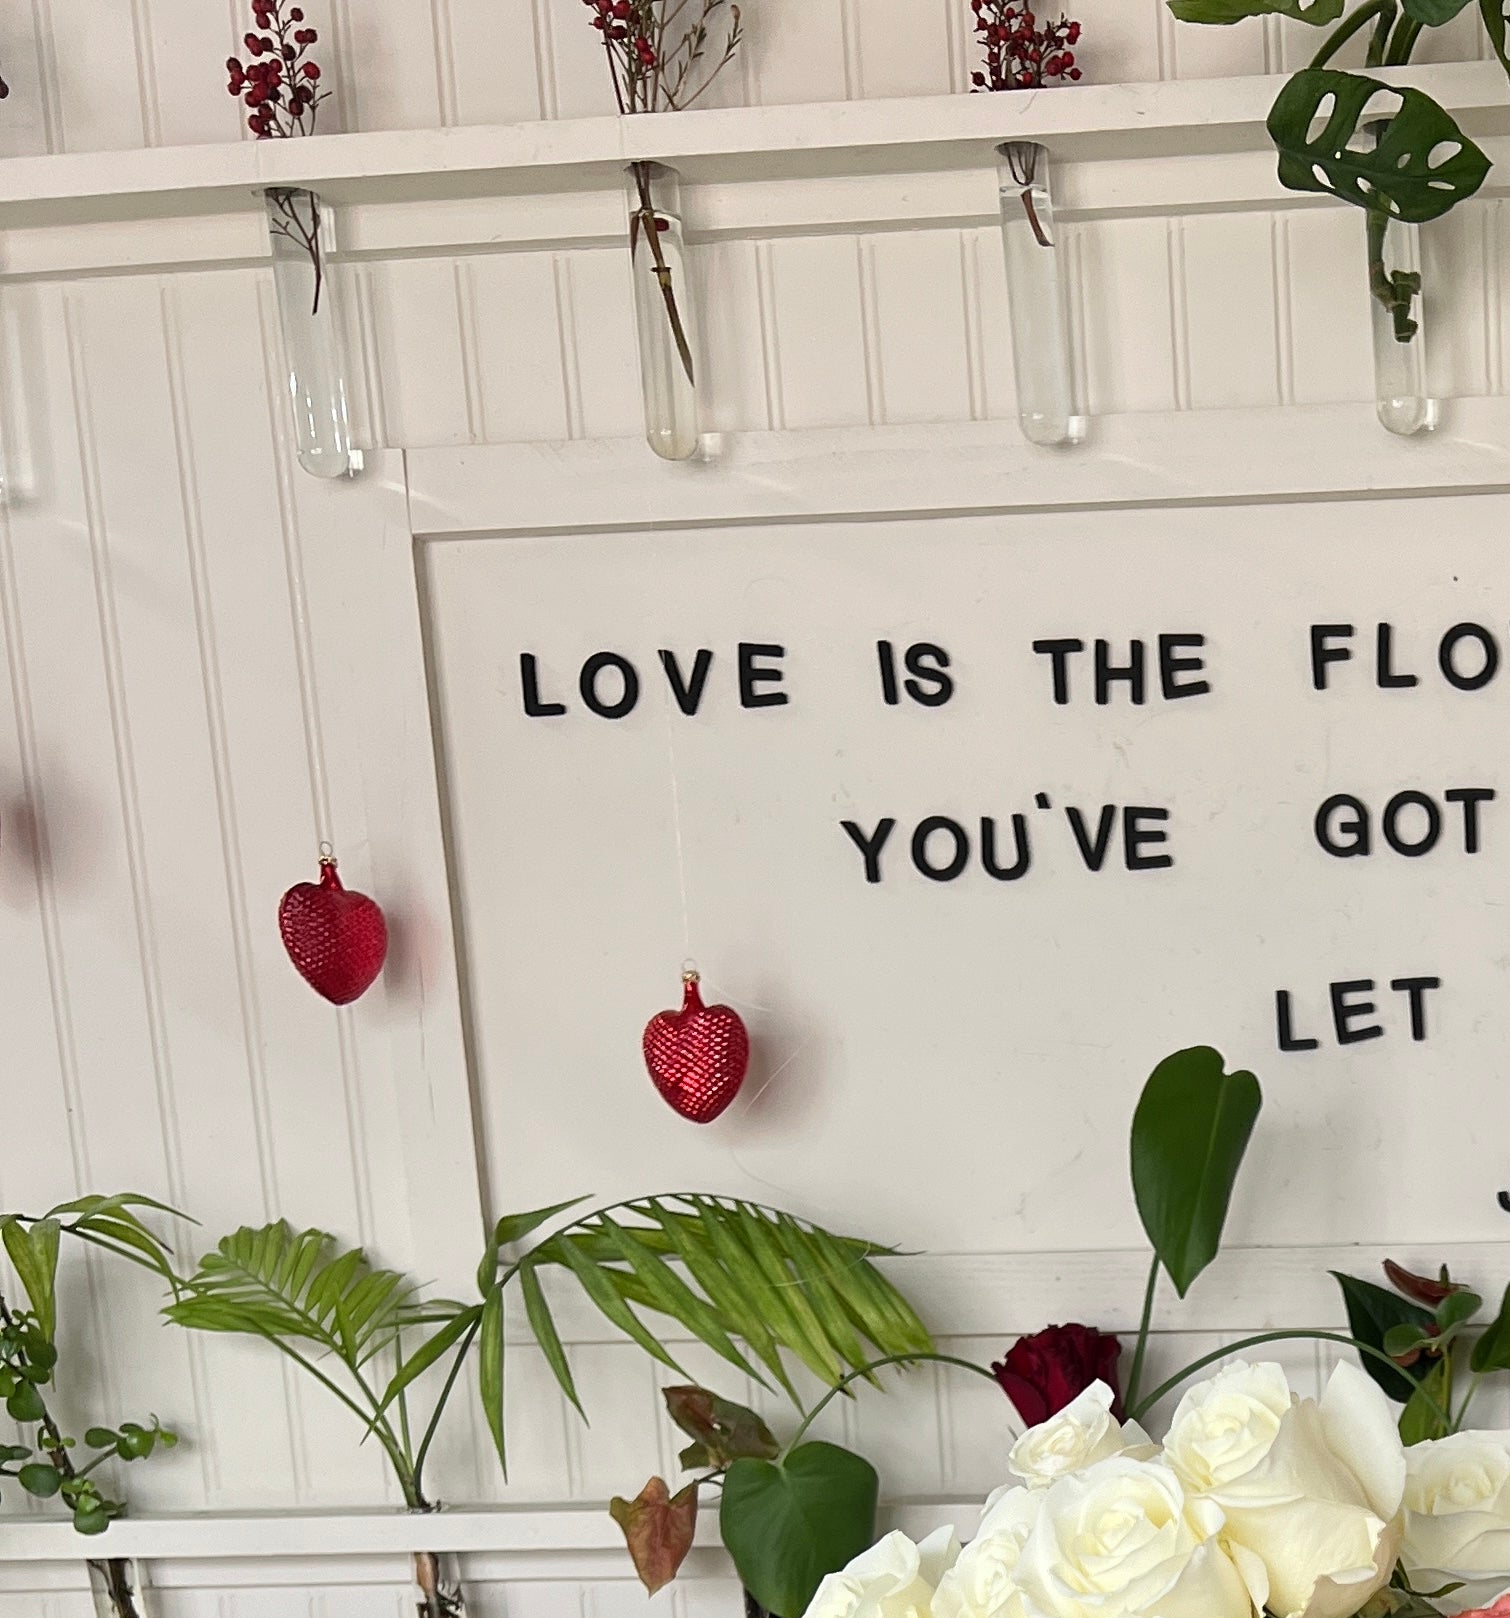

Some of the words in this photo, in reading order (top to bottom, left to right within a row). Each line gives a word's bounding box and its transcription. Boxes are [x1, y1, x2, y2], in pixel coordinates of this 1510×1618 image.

[518, 642, 790, 720] LOVE
[875, 639, 956, 707] IS
[1032, 633, 1212, 706] THE
[839, 791, 1175, 884] YOU'VE
[1313, 787, 1497, 858] GOT
[1274, 976, 1442, 1053] LET
